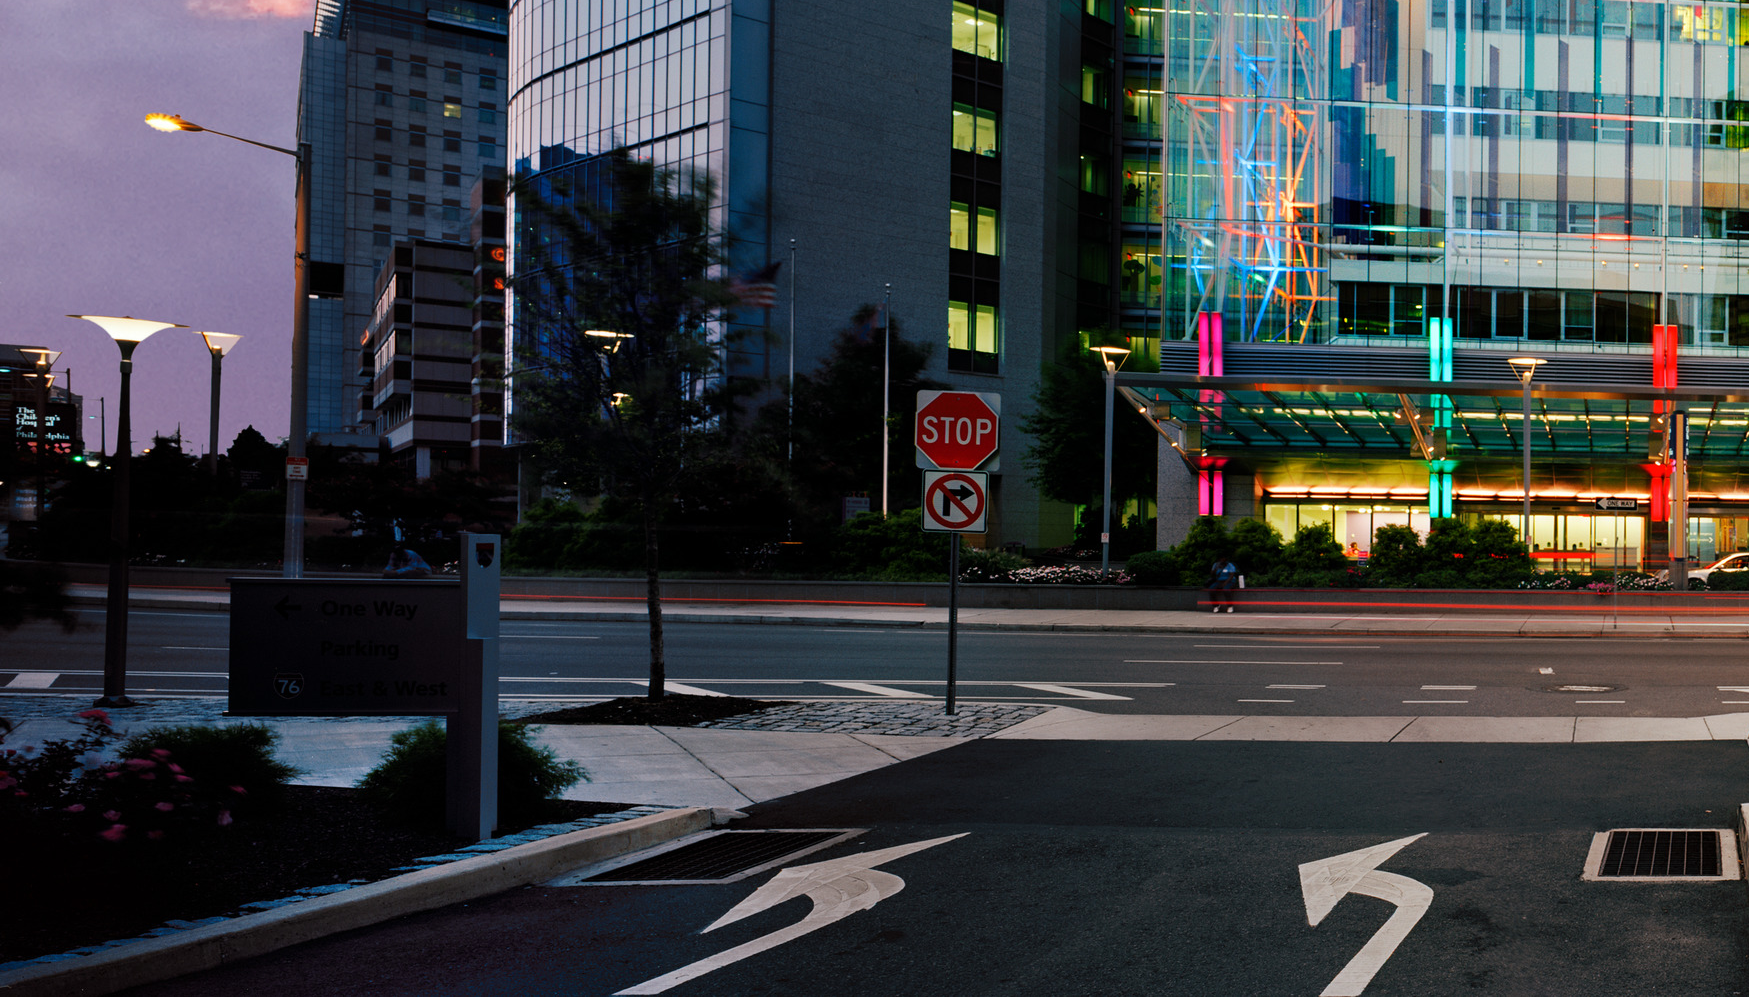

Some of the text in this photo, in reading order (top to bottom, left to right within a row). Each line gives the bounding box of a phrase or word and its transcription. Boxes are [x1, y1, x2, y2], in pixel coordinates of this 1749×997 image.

[15, 413, 61, 421] Chilen's
[16, 406, 35, 414] The
[922, 415, 992, 445] STOP
[321, 600, 418, 621] One Way
[320, 640, 399, 660] Parking
[277, 679, 301, 694] 76
[320, 681, 448, 696] East & West
